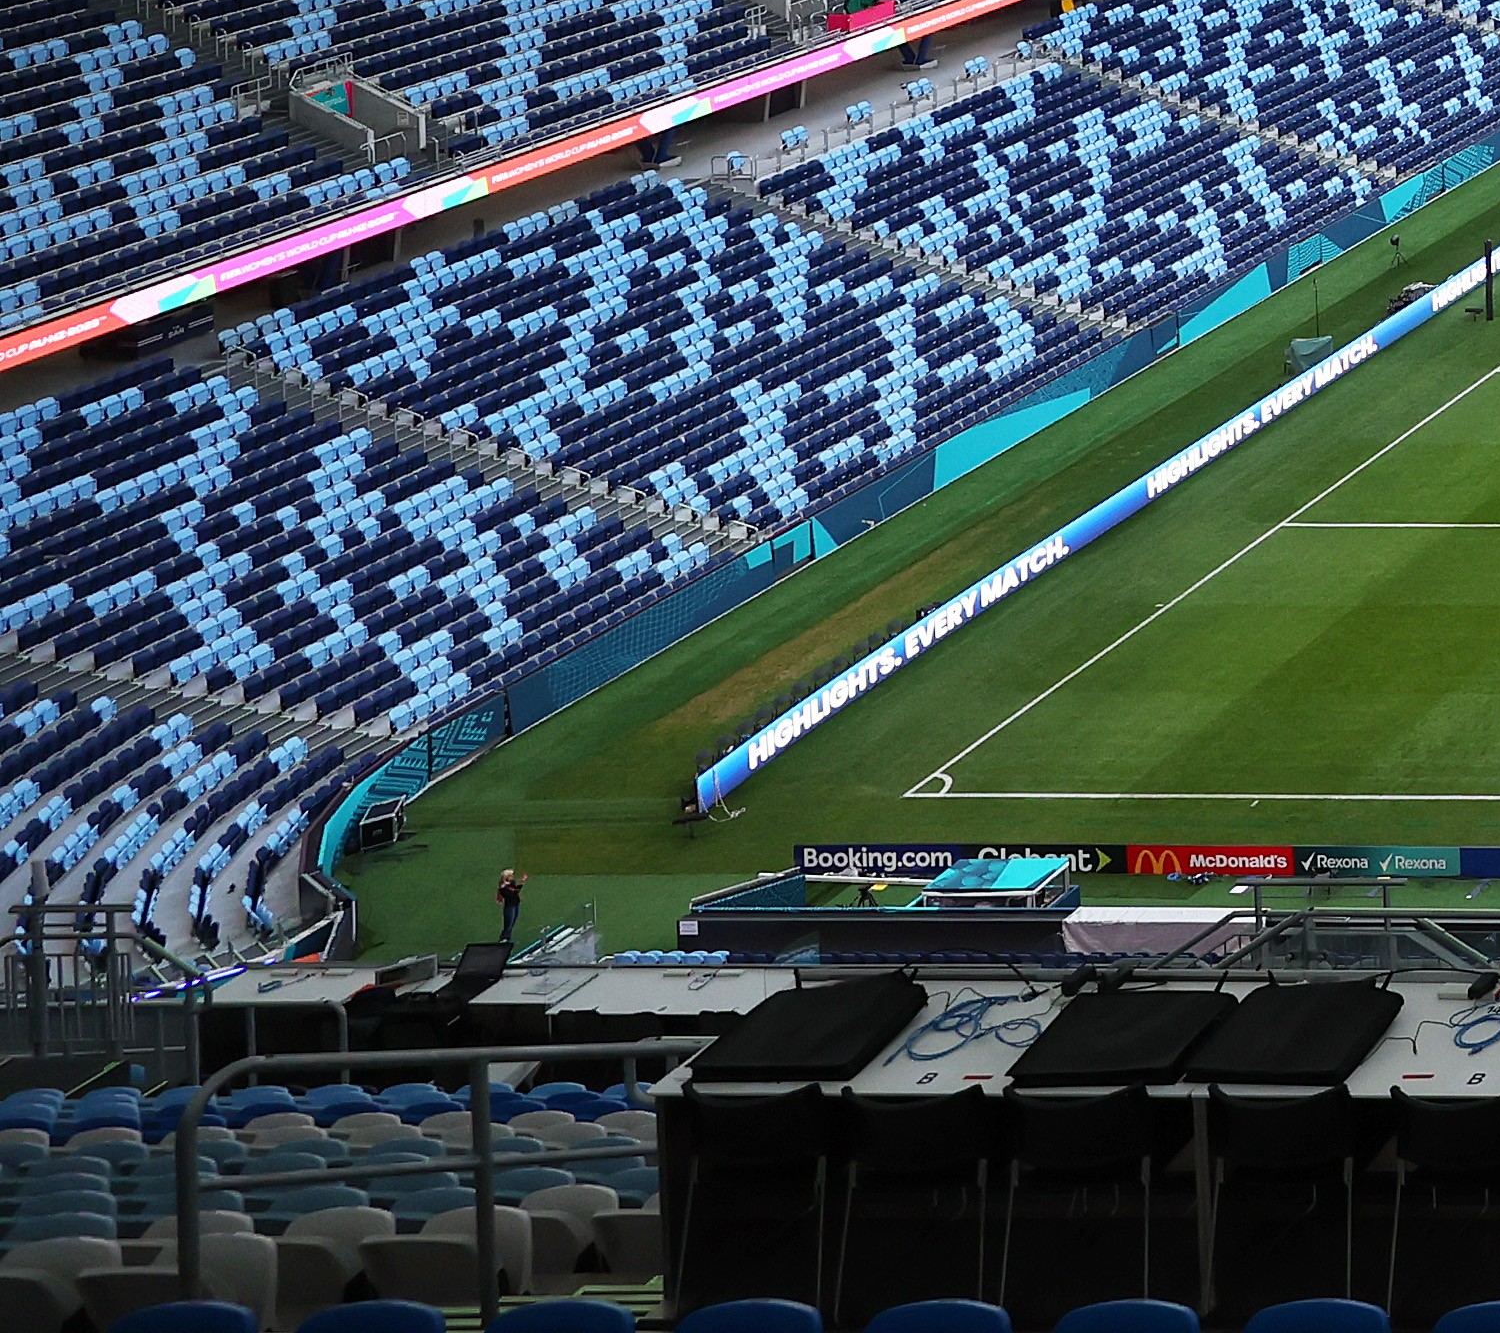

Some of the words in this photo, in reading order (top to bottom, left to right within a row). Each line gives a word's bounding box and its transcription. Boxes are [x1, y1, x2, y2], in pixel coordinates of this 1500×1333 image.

[220, 267, 242, 282] FIFA
[286, 243, 317, 264] WORLD
[1147, 410, 1261, 499] HIGHLIGHTS.
[1260, 374, 1316, 425] EVERY
[1315, 335, 1379, 391] MATCH.
[748, 645, 904, 770] HIGHLIGHTS.
[904, 589, 979, 660] EVERY
[980, 534, 1071, 608] MATCH.
[803, 847, 953, 872] Booking.com
[1190, 854, 1288, 870] McDonald's
[1316, 854, 1369, 870] Rexona
[1395, 855, 1447, 871] Rexona
[916, 1072, 939, 1084] B
[1467, 1073, 1486, 1085] B
